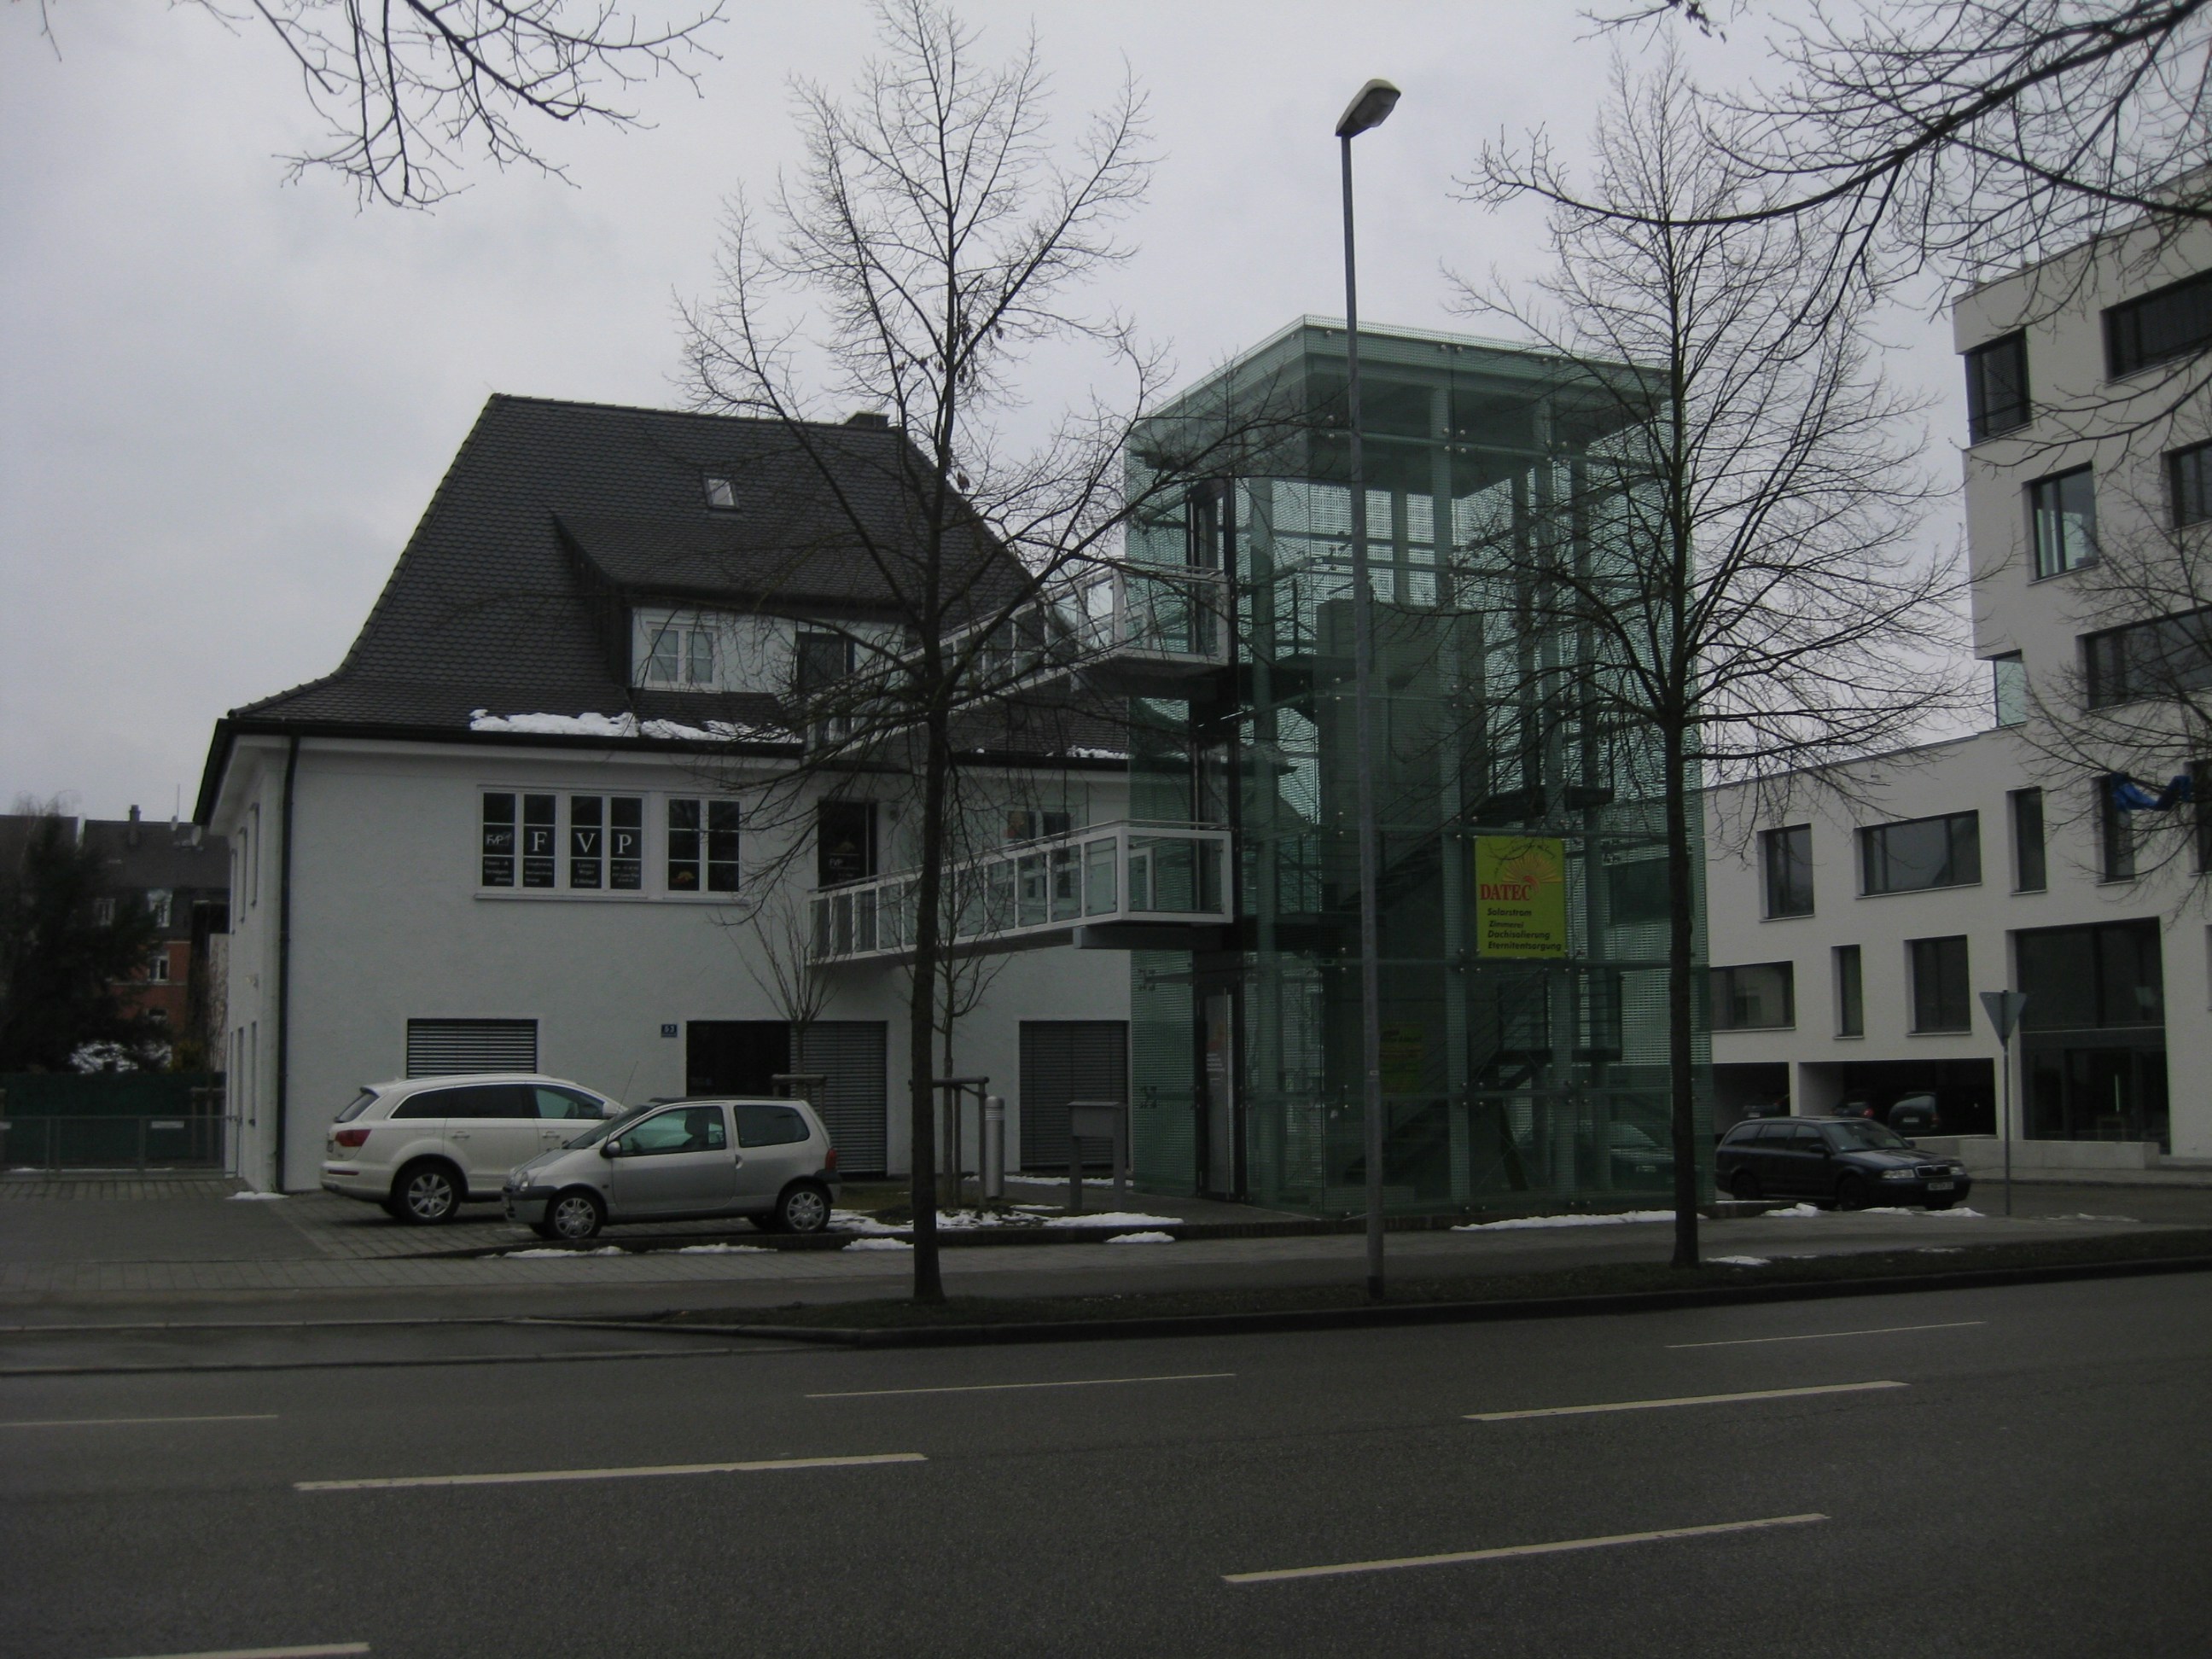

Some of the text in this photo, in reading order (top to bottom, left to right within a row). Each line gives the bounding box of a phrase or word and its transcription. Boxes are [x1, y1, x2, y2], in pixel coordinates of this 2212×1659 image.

[532, 831, 632, 854] F V P
[1481, 884, 1531, 900] DATEC
[1489, 920, 1524, 928] Zimmerei
[1488, 930, 1550, 940] Dachisolierung
[1488, 941, 1561, 951] Eternitentsorgung
